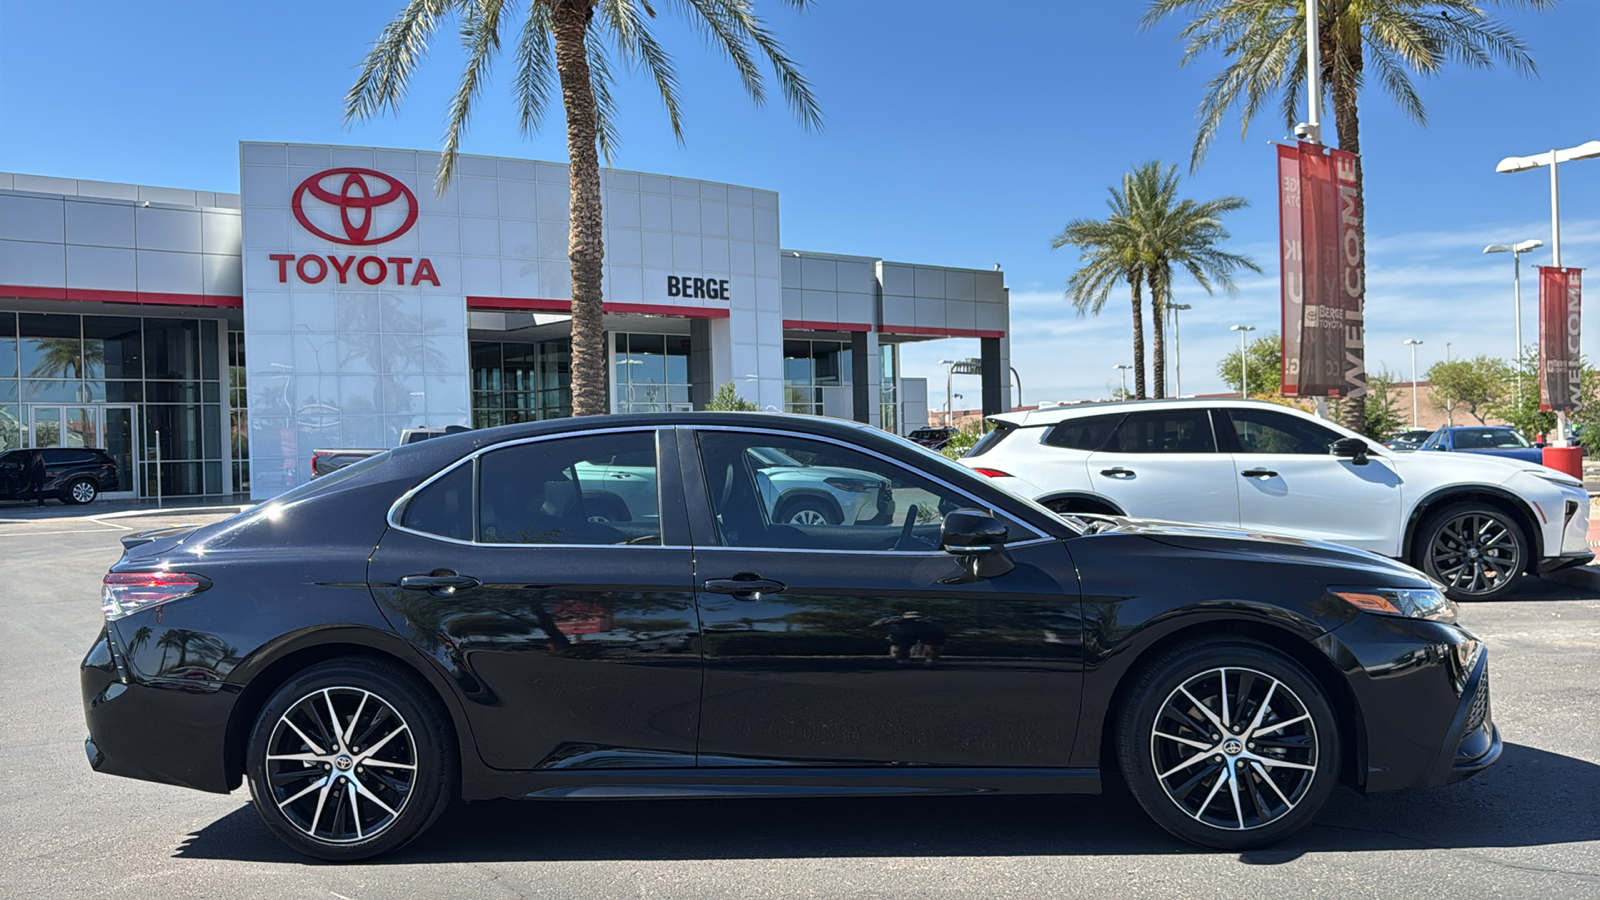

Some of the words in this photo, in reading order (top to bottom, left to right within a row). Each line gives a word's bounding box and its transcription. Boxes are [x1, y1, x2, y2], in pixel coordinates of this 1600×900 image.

[269, 254, 441, 287] TOYOTA
[1338, 157, 1365, 397] WELCOME
[667, 275, 730, 301] BERGE
[1319, 304, 1344, 320] BERGE
[1319, 319, 1343, 329] TOYOTA
